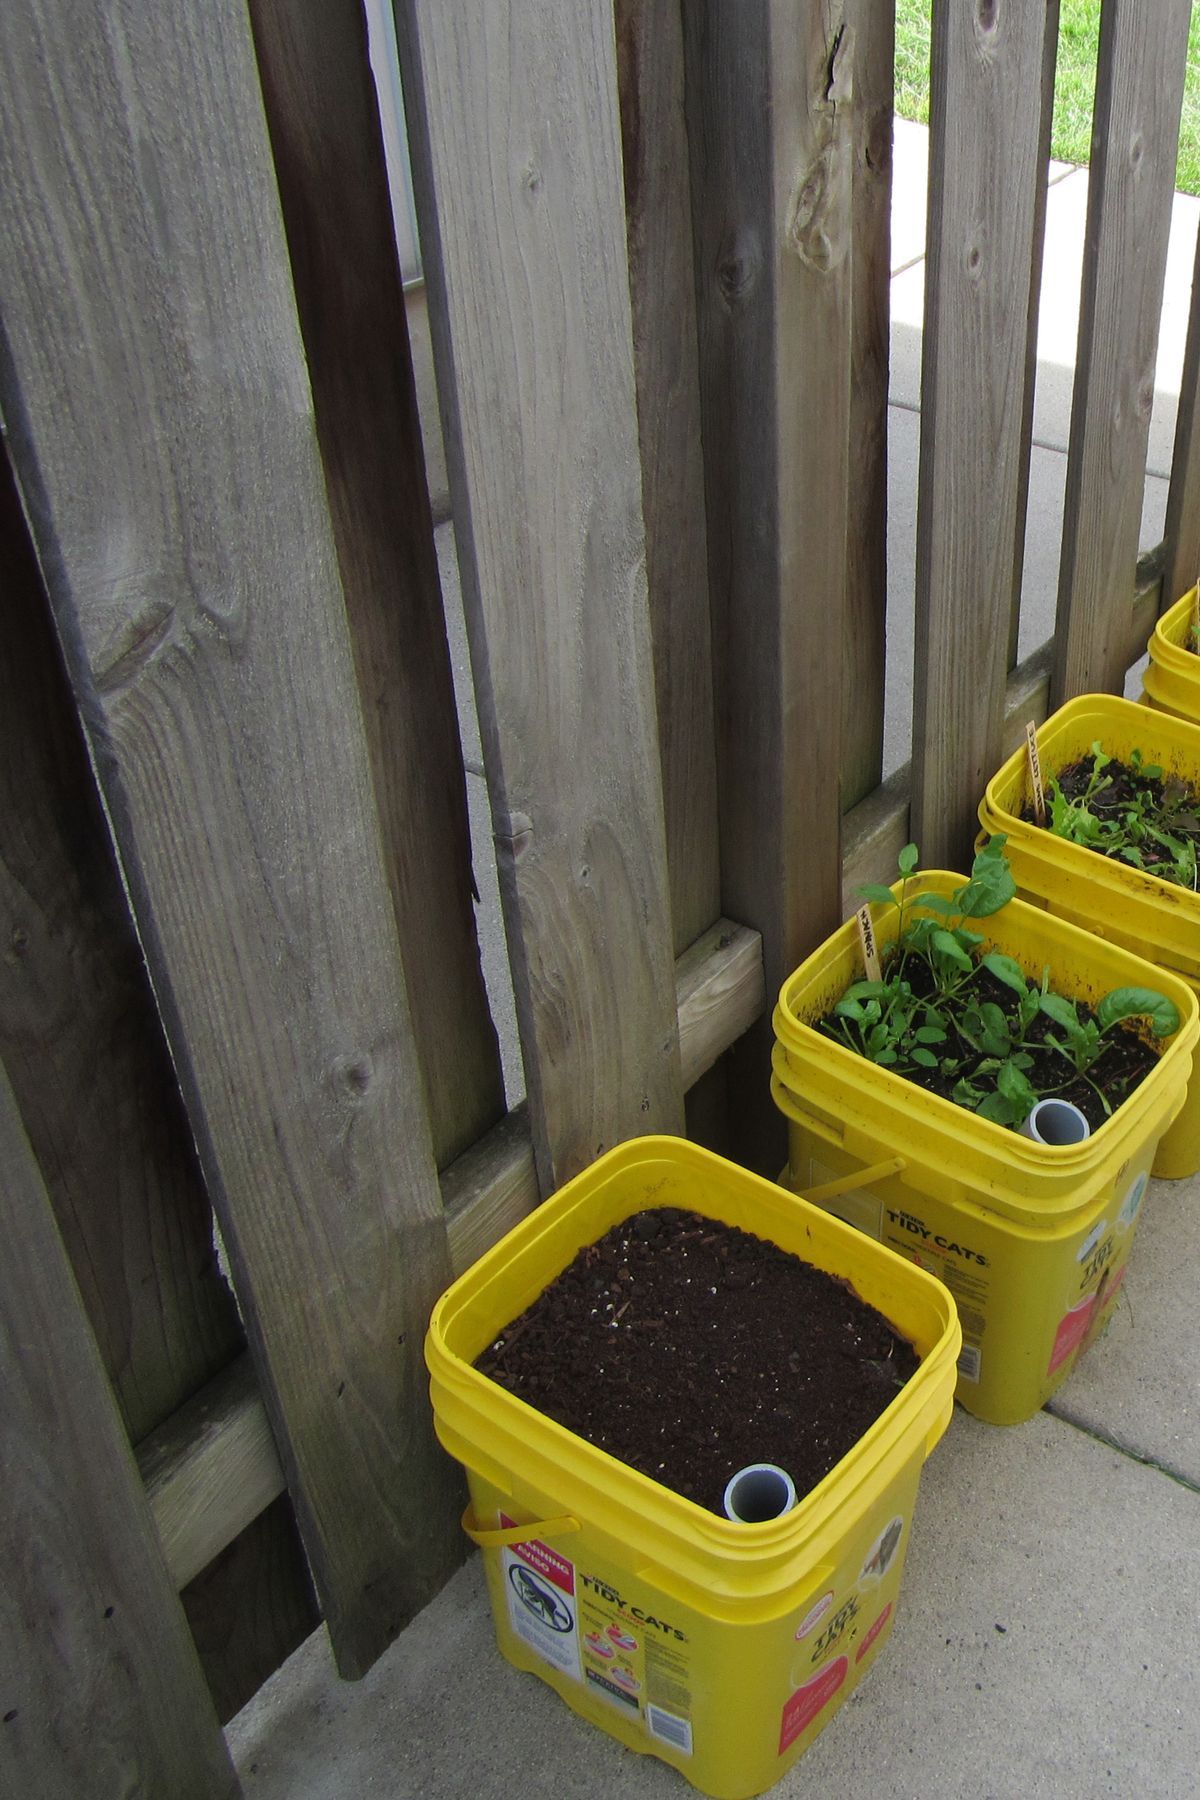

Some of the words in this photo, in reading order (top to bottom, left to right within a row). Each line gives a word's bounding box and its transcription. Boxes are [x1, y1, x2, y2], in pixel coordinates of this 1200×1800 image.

[886, 1209, 932, 1238] TIDY
[934, 1235, 986, 1267] CATS
[525, 1541, 570, 1575] ARNING
[579, 1573, 628, 1609] TIDY
[631, 1607, 685, 1642] CATS
